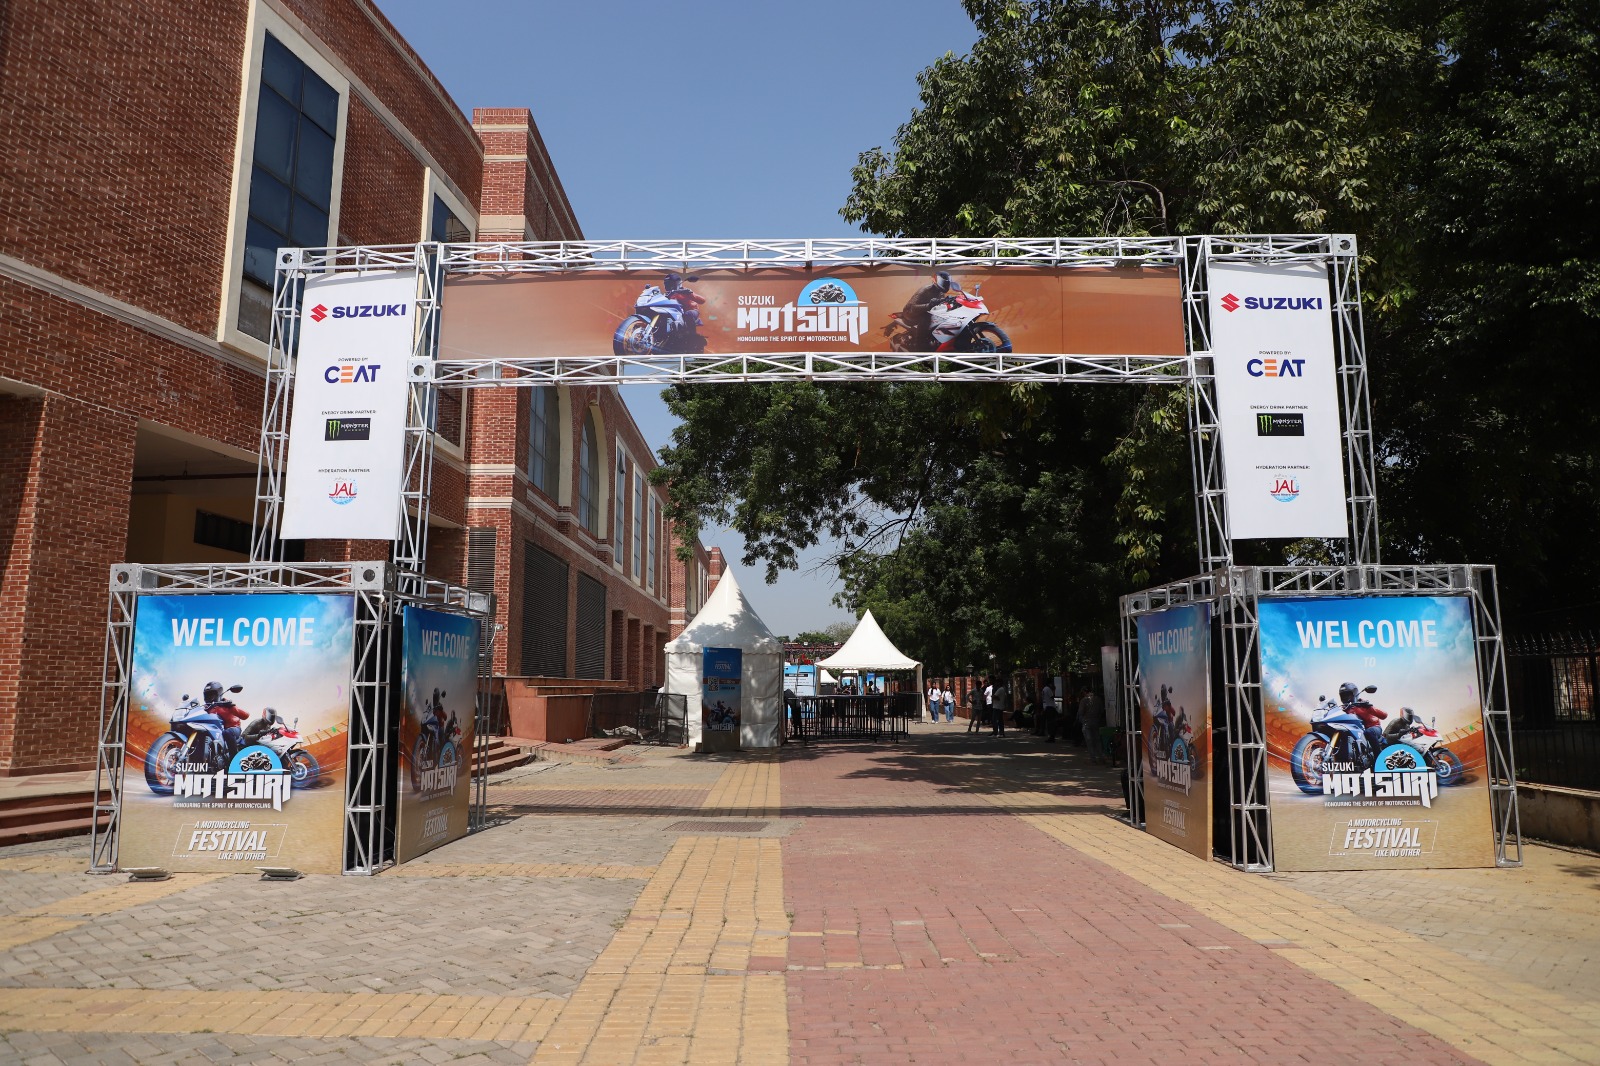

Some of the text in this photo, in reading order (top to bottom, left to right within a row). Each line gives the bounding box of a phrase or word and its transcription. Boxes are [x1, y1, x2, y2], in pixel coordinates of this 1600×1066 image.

[738, 296, 775, 305] SUZUKI
[1244, 297, 1322, 310] SUZUKI
[332, 304, 406, 318] SUZUKI
[737, 301, 868, 345] MATSURI
[324, 365, 381, 383] CEAT
[1247, 359, 1305, 377] CEAT
[329, 483, 357, 496] JAL
[1270, 480, 1299, 493] JAL
[171, 617, 314, 646] WELCOME
[1148, 626, 1193, 655] WELCOME
[1296, 619, 1438, 648] WELCOME
[421, 629, 471, 659] WELCOME
[233, 655, 246, 666] TO
[1363, 657, 1376, 668] TO
[175, 763, 209, 773] SUZUKI
[1322, 762, 1354, 772] SUZUKI
[421, 764, 457, 796] MATSURI
[1157, 758, 1192, 796] MATSURI
[174, 769, 291, 812] MATSURI
[1322, 768, 1437, 808] MATSURI
[194, 821, 250, 829] A MOTORCYCLING
[424, 813, 448, 838] FESTIVAL
[1163, 807, 1185, 830] FESTIVAL
[1348, 818, 1402, 827] A MOTORCYCLING
[188, 830, 267, 851] FESTIVAL
[1344, 827, 1421, 848] FESTIVAL
[1390, 849, 1399, 857] NO
[1400, 849, 1421, 857] OTHER
